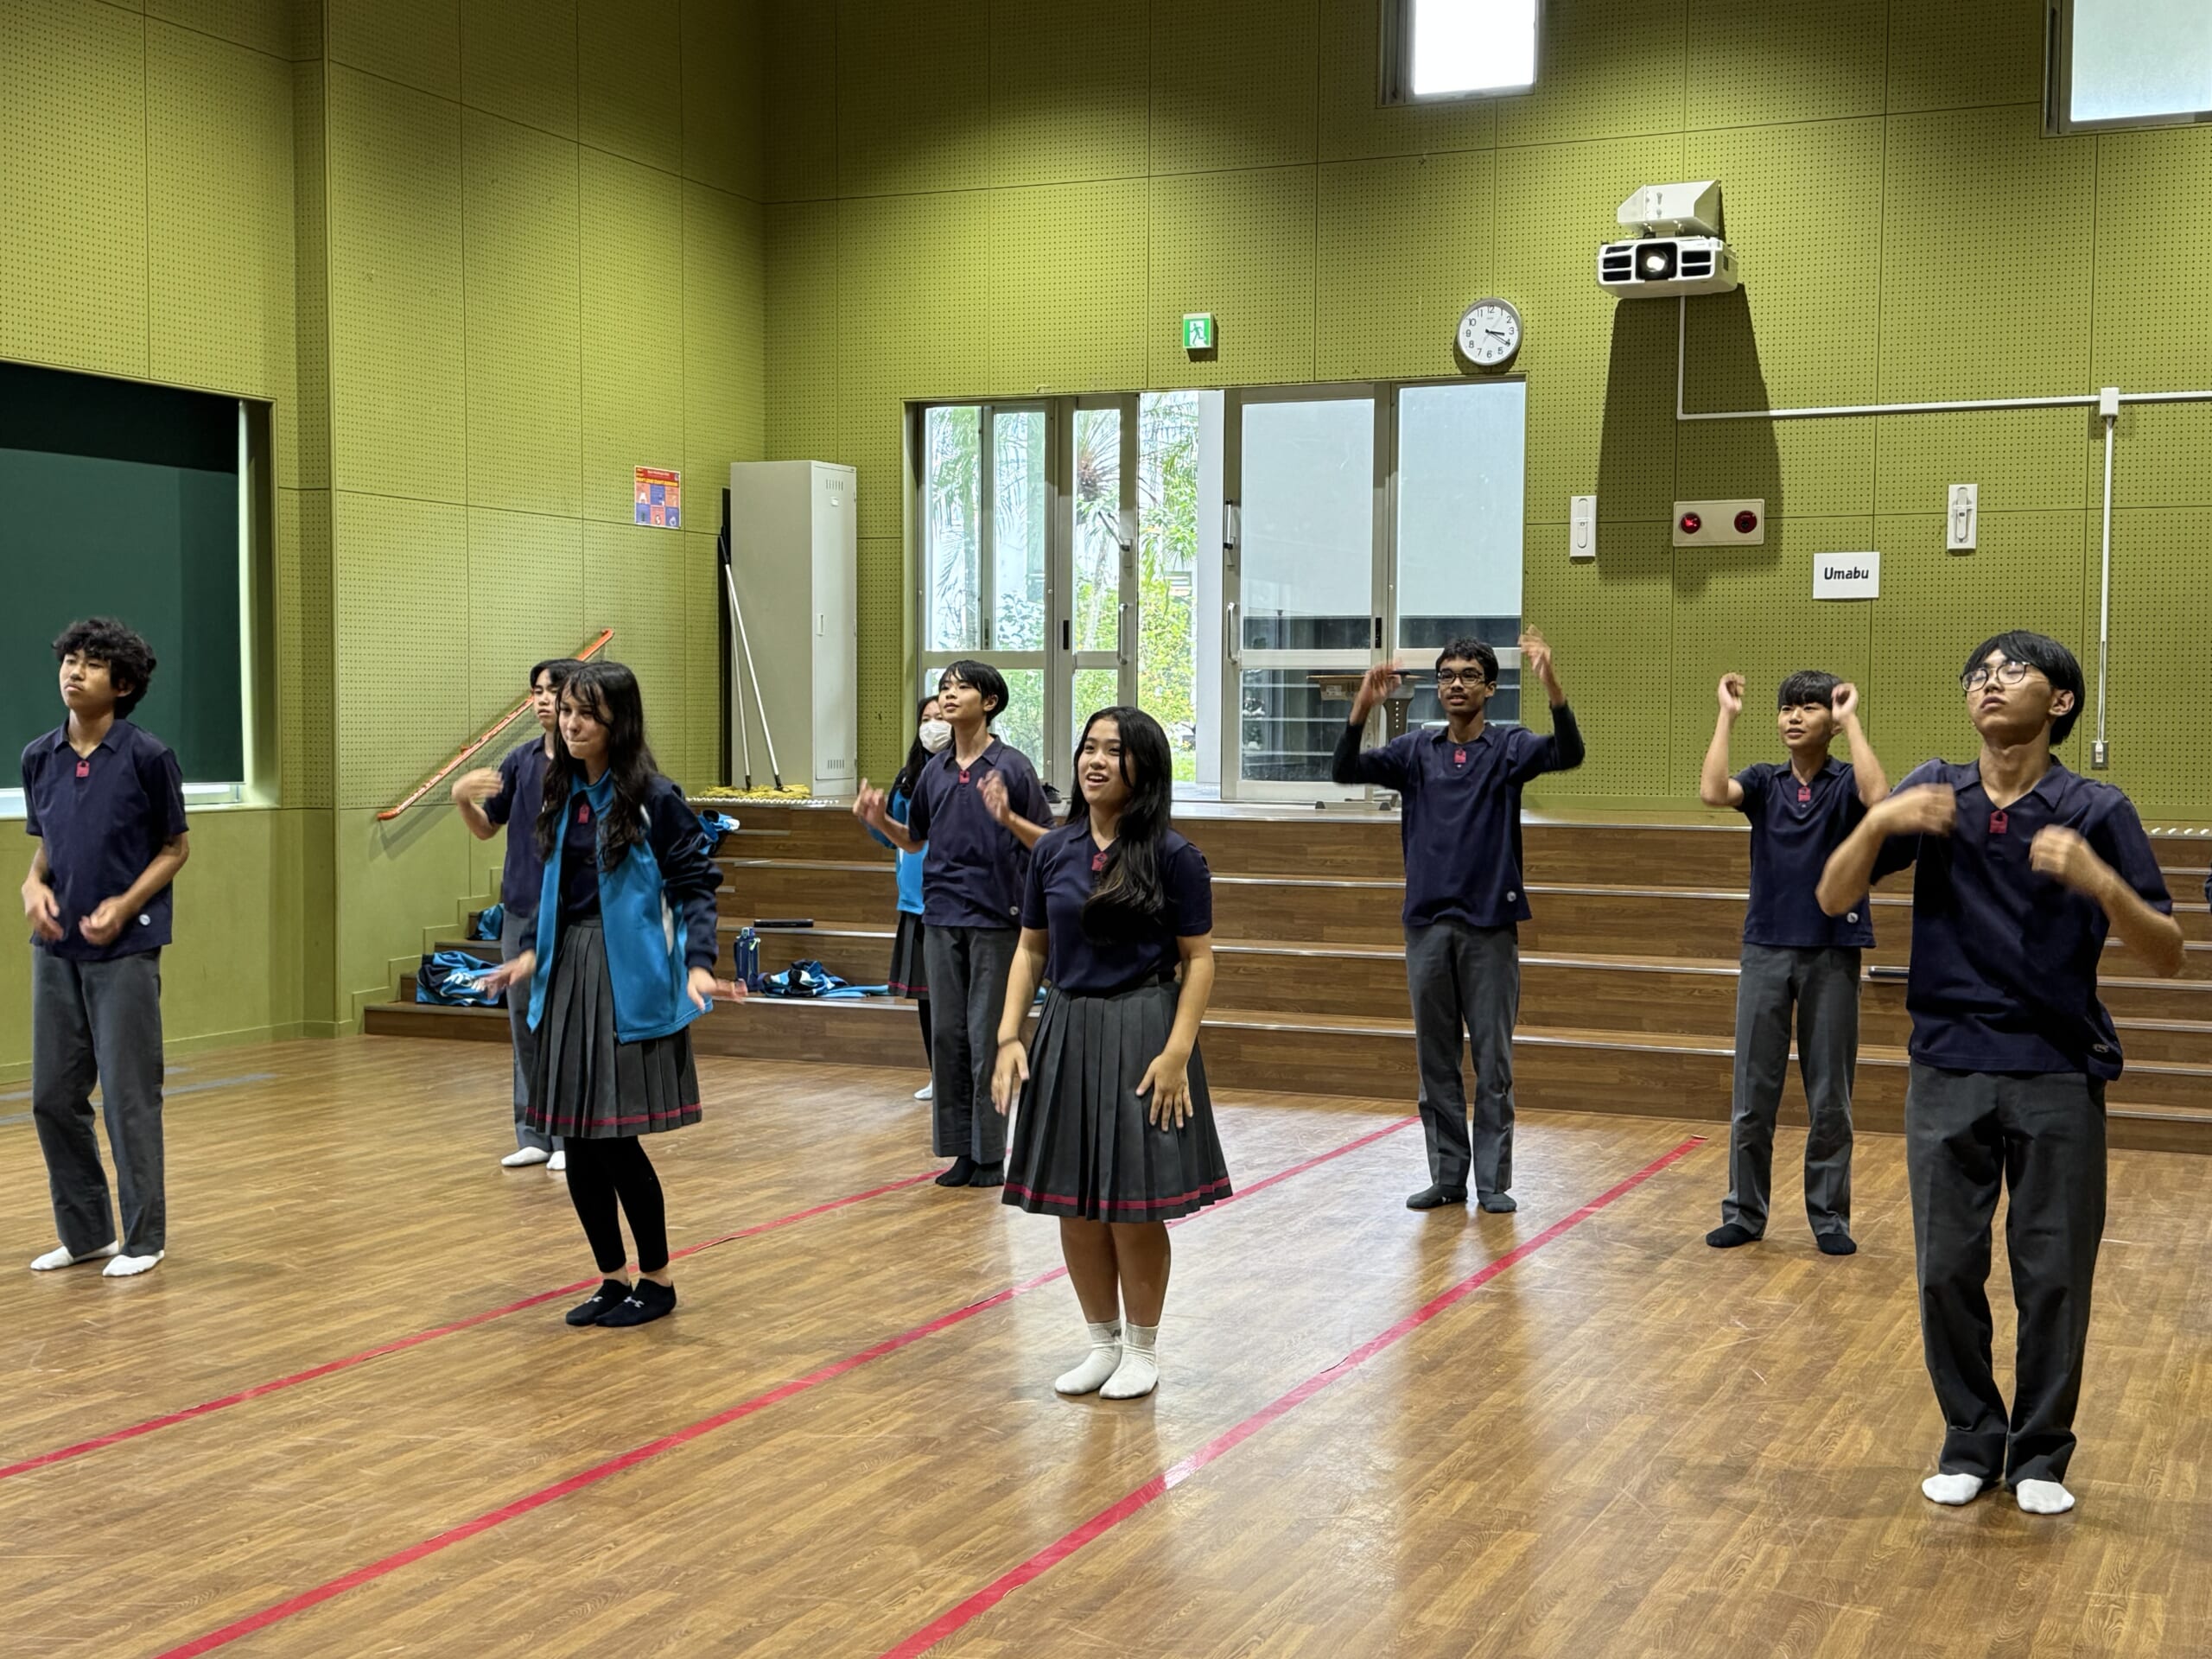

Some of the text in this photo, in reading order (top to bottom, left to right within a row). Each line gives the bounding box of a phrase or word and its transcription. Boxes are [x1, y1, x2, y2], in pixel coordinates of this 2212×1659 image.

[1478, 308, 1483, 317] 11
[1487, 304, 1495, 314] 12
[1469, 318, 1477, 327] 10
[1506, 315, 1512, 324] 2
[1465, 329, 1471, 338] 9
[1509, 327, 1514, 335] 3
[1469, 340, 1474, 348] 8
[1477, 347, 1482, 356] 7
[1486, 350, 1492, 359] 6
[1824, 566, 1869, 580] Umabu
